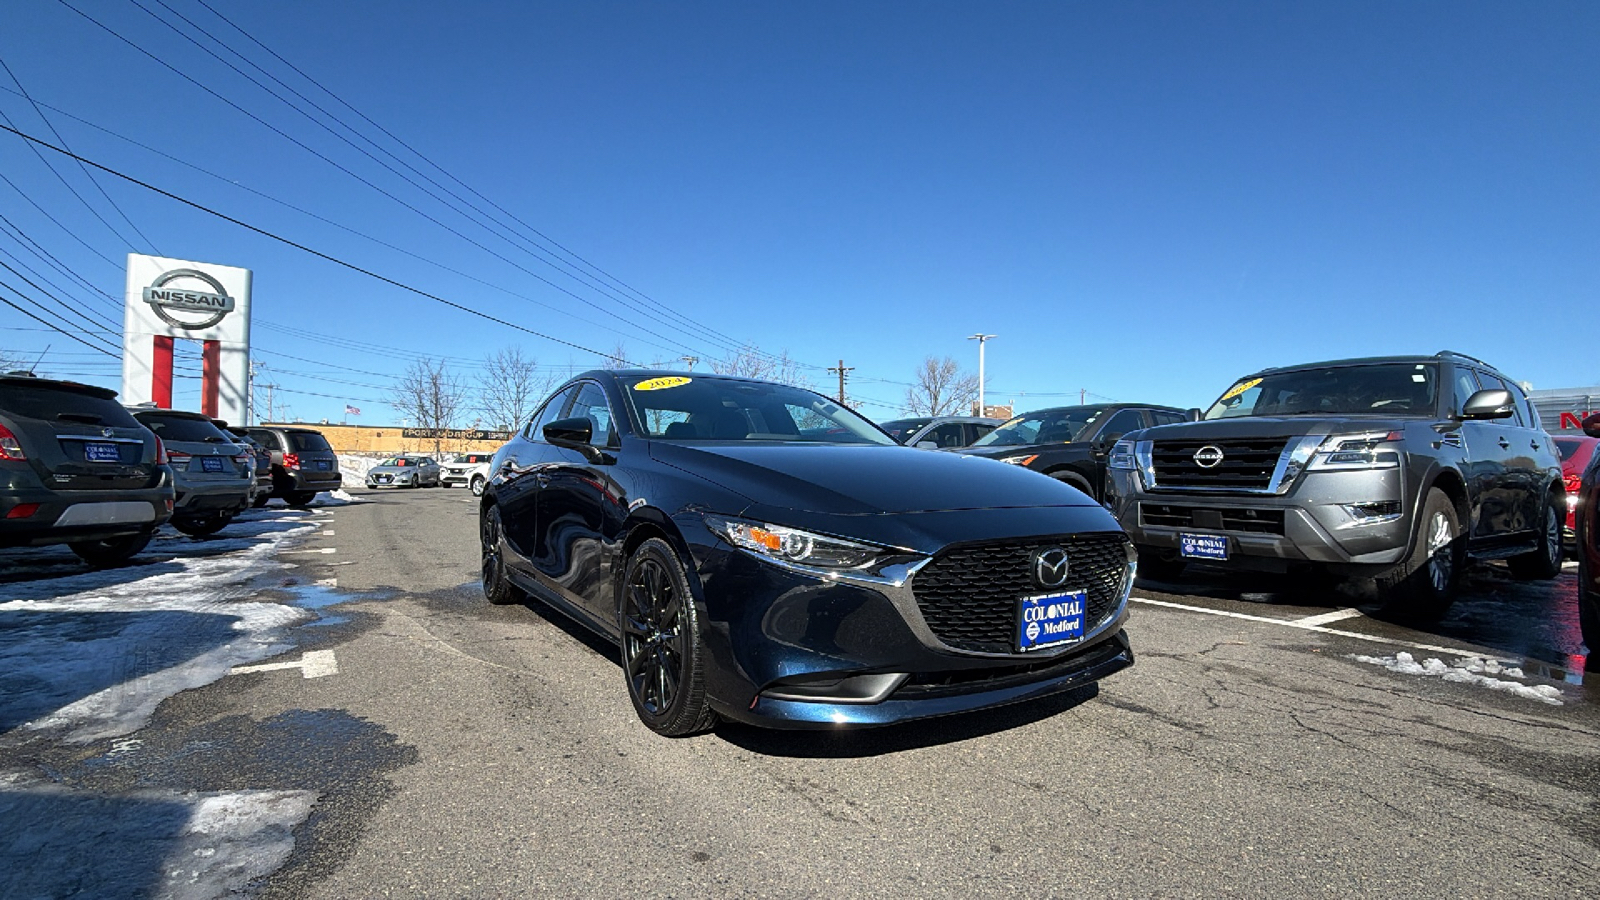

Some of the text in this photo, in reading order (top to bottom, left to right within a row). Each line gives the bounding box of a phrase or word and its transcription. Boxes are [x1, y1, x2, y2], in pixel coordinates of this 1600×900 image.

[151, 290, 226, 307] NISSAN
[1560, 411, 1600, 429] N
[1182, 537, 1226, 549] COLONIAL
[1196, 546, 1224, 555] Medford
[1024, 601, 1083, 622] COLONIAL
[1043, 618, 1080, 635] Medford
